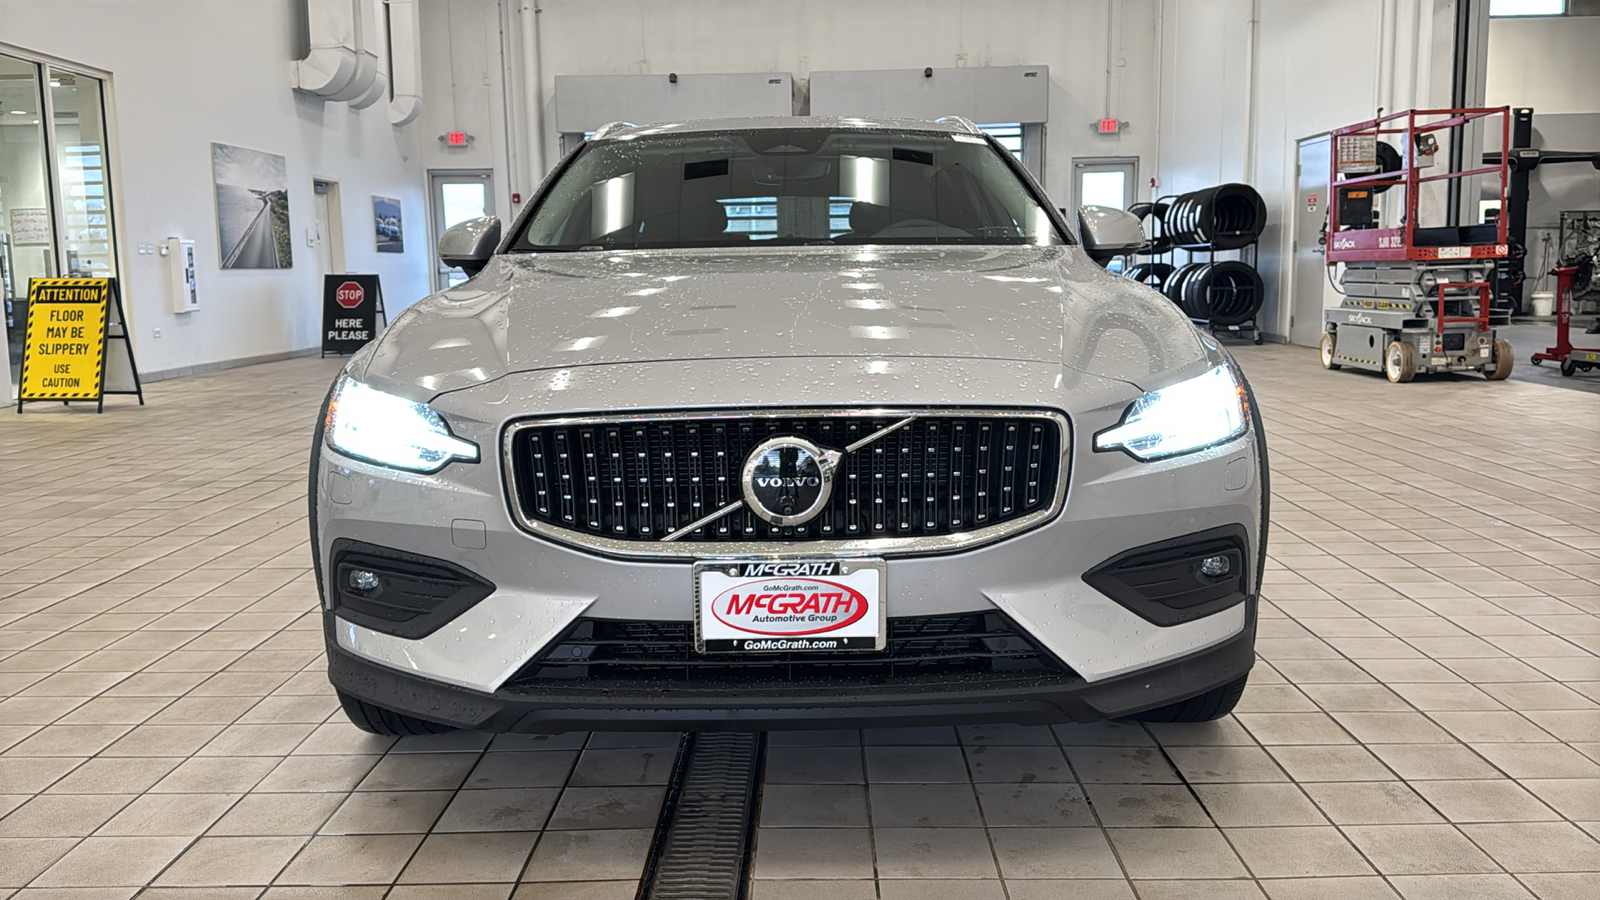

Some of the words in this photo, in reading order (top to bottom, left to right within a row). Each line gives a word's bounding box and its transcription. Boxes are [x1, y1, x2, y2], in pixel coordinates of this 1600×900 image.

[1101, 119, 1116, 131] EXIT
[449, 133, 464, 145] EXIT
[38, 288, 99, 301] ATTENTION
[338, 289, 362, 300] STOP
[49, 309, 84, 322] FLOOR
[1348, 312, 1372, 325] SKYJACK
[335, 318, 363, 328] HERE
[46, 326, 68, 338] MAY
[70, 326, 85, 338] BE
[327, 330, 369, 340] PLEASE
[38, 343, 90, 355] SLIPPERY
[53, 363, 71, 374] USE
[41, 377, 80, 388] CAUTION
[755, 476, 820, 487] VOLVO
[752, 614, 806, 623] Automotive
[807, 614, 838, 623] Group
[743, 639, 837, 650] GoMcGrath.com
